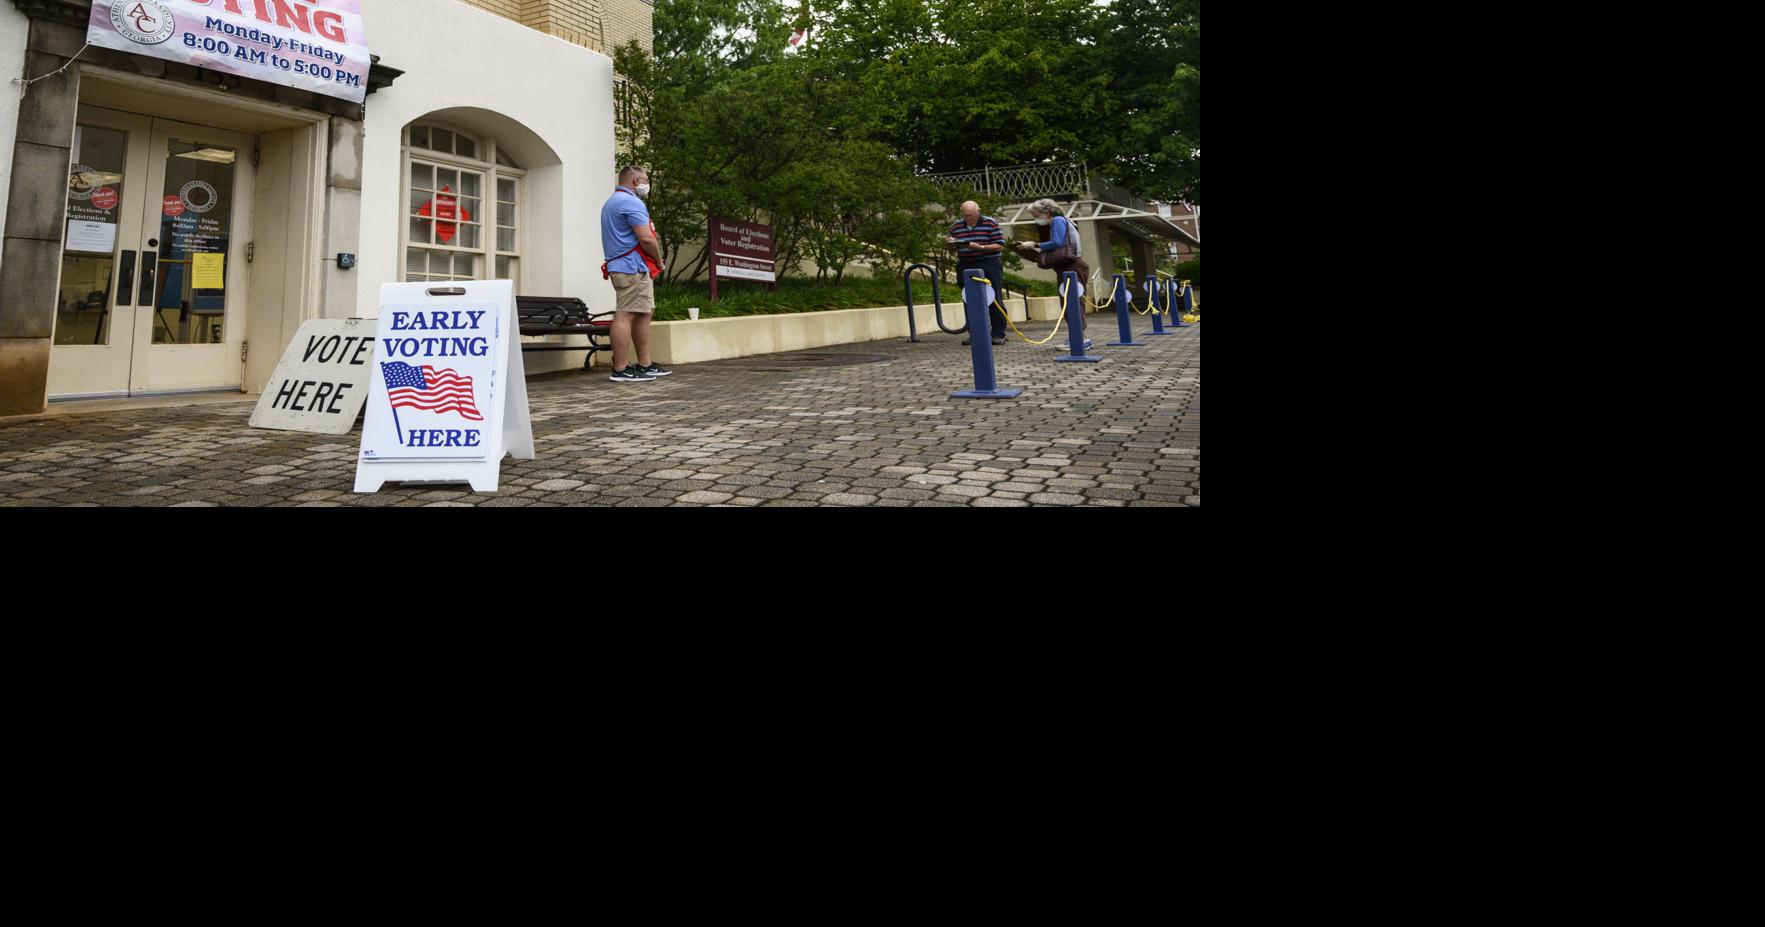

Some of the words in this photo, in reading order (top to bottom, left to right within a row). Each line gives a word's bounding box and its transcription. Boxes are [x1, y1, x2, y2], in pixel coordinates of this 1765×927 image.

[122, 29, 162, 43] GEORGIA
[205, 16, 344, 65] Monday-Friday
[183, 32, 230, 55] 8:00
[234, 45, 266, 64] AM
[271, 54, 290, 69] to
[294, 59, 332, 79] 5:00
[335, 69, 360, 87] PM
[72, 205, 103, 214] Elections
[174, 215, 197, 223] Monday
[720, 223, 738, 233] Board
[745, 228, 770, 239] Elections
[720, 237, 737, 246] Voter
[737, 240, 770, 252] Registration
[734, 260, 759, 269] Washington
[390, 310, 486, 331] EARLY
[302, 335, 375, 365] VOTE
[383, 337, 488, 357] VOTING
[272, 379, 353, 414] HERE
[407, 429, 481, 447] HERE
